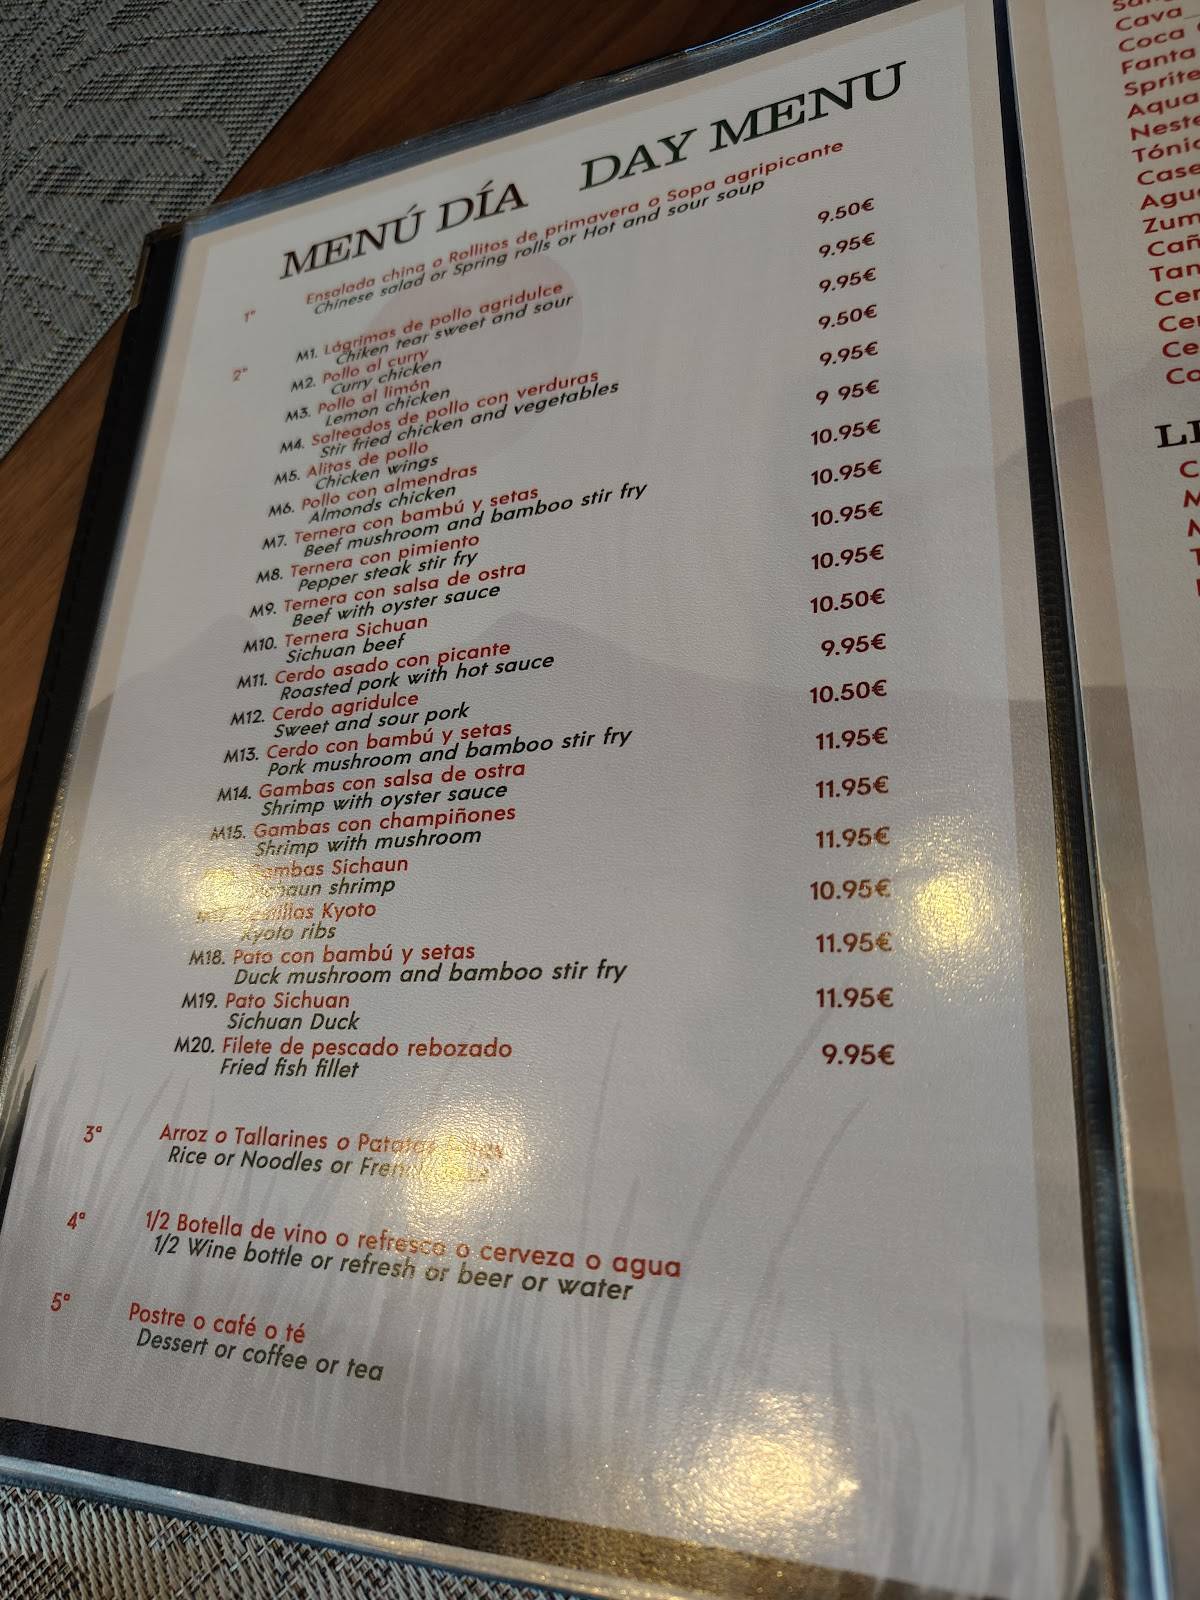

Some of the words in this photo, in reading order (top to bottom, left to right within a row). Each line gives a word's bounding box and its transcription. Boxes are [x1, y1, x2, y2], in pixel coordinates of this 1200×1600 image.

[1116, 8, 1182, 31] Cava
[1119, 29, 1184, 52] Coca
[1122, 48, 1195, 74] Fanta
[1124, 70, 1200, 96] Sprite
[578, 126, 698, 192] DAY
[708, 59, 908, 153] MENU
[305, 275, 375, 305] Ensalada
[381, 262, 425, 283] china
[431, 257, 443, 269] o
[448, 238, 509, 263] Rollitos
[515, 229, 538, 245] de
[544, 201, 640, 239] primavera
[647, 195, 661, 208] o
[666, 178, 716, 202] Sopa
[723, 141, 844, 185] agripicante
[816, 196, 875, 225] 9.50€
[278, 202, 427, 281] MENÚ
[434, 178, 530, 234] DÍA
[817, 230, 876, 259] 9.95€
[313, 290, 374, 315] Chinese
[379, 271, 426, 297] salad
[429, 269, 448, 283] or
[452, 252, 508, 277] Spring
[513, 238, 551, 260] rolls
[556, 233, 577, 248] or
[582, 220, 617, 241] Hot
[621, 205, 662, 229] and
[666, 195, 710, 217] sour
[715, 179, 765, 203] soup
[818, 266, 877, 294] 9.95€
[817, 303, 878, 331] 9.50€
[818, 339, 879, 368] 9.95€
[289, 375, 317, 393] M2.
[321, 365, 360, 384] Pollo
[366, 356, 382, 373] al
[386, 350, 429, 368] curry
[330, 377, 373, 396] Curry
[377, 357, 443, 384] chicken
[283, 405, 312, 423] M3.
[316, 395, 356, 415] Pollo
[361, 389, 378, 404] al
[383, 378, 430, 398] limón
[324, 405, 379, 427] Lemon
[384, 387, 451, 413] chicken
[809, 417, 882, 447] 10.95€
[272, 468, 301, 486] M5.
[305, 460, 352, 478] Alitas
[357, 451, 380, 466] de
[384, 439, 429, 464] pollo
[314, 467, 380, 491] Chicken
[384, 455, 439, 476] wings
[810, 457, 883, 487] 10.95€
[267, 500, 295, 518] M6.
[300, 491, 341, 511] Pollo
[346, 485, 378, 502] con
[383, 463, 478, 494] almendras
[307, 496, 383, 525] Almonds
[387, 485, 457, 509] chicken
[810, 499, 884, 528] 10.95€
[254, 566, 284, 585] M8.
[289, 557, 353, 577] Ternera
[358, 550, 391, 566] con
[397, 534, 480, 562] pimiento
[296, 571, 360, 593] Pepper
[362, 558, 412, 582] steak
[417, 554, 448, 573] stir
[452, 549, 479, 568] fry
[810, 542, 885, 571] 10.95€
[808, 586, 886, 614] 10.50€
[242, 635, 278, 655] M10.
[283, 628, 350, 647] Ternera
[355, 616, 428, 638] Sichuan
[284, 643, 356, 664] Sichuan
[361, 631, 407, 654] beef
[819, 631, 887, 657] 9.95€
[235, 671, 268, 690] M11.
[274, 664, 326, 685] Cerdo
[332, 655, 389, 677] asado
[395, 653, 430, 670] con
[436, 641, 511, 668] picante
[279, 676, 354, 701] Roasted
[356, 670, 401, 696] pork
[407, 664, 448, 686] with
[454, 661, 490, 680] hot
[493, 655, 555, 675] sauce
[809, 678, 888, 705] 10.50€
[228, 708, 265, 727] M12.
[271, 701, 324, 722] Cerdo
[330, 691, 419, 717] agridulce
[272, 719, 330, 739] Sweet
[333, 711, 374, 732] and
[376, 711, 420, 728] sour
[423, 700, 472, 726] pork
[814, 725, 889, 751] 11.95€
[815, 774, 889, 799] 11.95€
[814, 825, 891, 849] 11.95€
[809, 876, 892, 901] 10.95€
[815, 930, 893, 954] 11.95€
[180, 991, 218, 1009] M19.
[224, 991, 267, 1009] Pato
[272, 990, 350, 1009] Sichuan
[815, 985, 894, 1009] 11.95€
[225, 1010, 303, 1031] Sichuan
[308, 1010, 361, 1031] Duck
[172, 1035, 215, 1054] M20.
[221, 1035, 273, 1055] Filete
[278, 1036, 305, 1057] de
[310, 1037, 400, 1060] pescado
[406, 1038, 513, 1059] rebozado
[820, 1042, 896, 1067] 9.95€
[218, 1056, 270, 1076] Fried
[272, 1057, 308, 1078] fish
[314, 1057, 360, 1079] fillet
[158, 1122, 209, 1143] Arroz
[213, 1129, 228, 1144] o
[233, 1125, 329, 1150] Tallarines
[335, 1135, 351, 1152] o
[166, 1144, 208, 1166] Rice
[213, 1151, 236, 1167] or
[239, 1148, 324, 1173] Noodles
[329, 1159, 354, 1175] or
[145, 1210, 171, 1232] 1/2
[176, 1212, 244, 1238] Botella
[249, 1219, 276, 1241] de
[283, 1222, 328, 1245] vino
[334, 1231, 350, 1248] o
[357, 1230, 447, 1257] refresco
[455, 1242, 471, 1259] o
[478, 1244, 576, 1269] cerveza
[584, 1253, 602, 1271] o
[610, 1255, 683, 1280] agua
[153, 1233, 180, 1256] 1/2
[187, 1236, 238, 1261] Wine
[242, 1240, 303, 1268] bottle
[309, 1253, 334, 1271] or
[339, 1251, 416, 1280] refresh
[424, 1264, 451, 1282] or
[456, 1260, 514, 1289] beer
[520, 1274, 549, 1293] or
[556, 1277, 634, 1301] water
[127, 1301, 186, 1328] Postre
[192, 1314, 206, 1331] o
[212, 1314, 257, 1337] café
[263, 1323, 278, 1340] o
[285, 1322, 306, 1344] té
[135, 1326, 209, 1356] Dessert
[213, 1342, 237, 1360] or
[241, 1344, 308, 1370] coffee
[314, 1357, 340, 1375] or
[345, 1357, 385, 1382] tea
